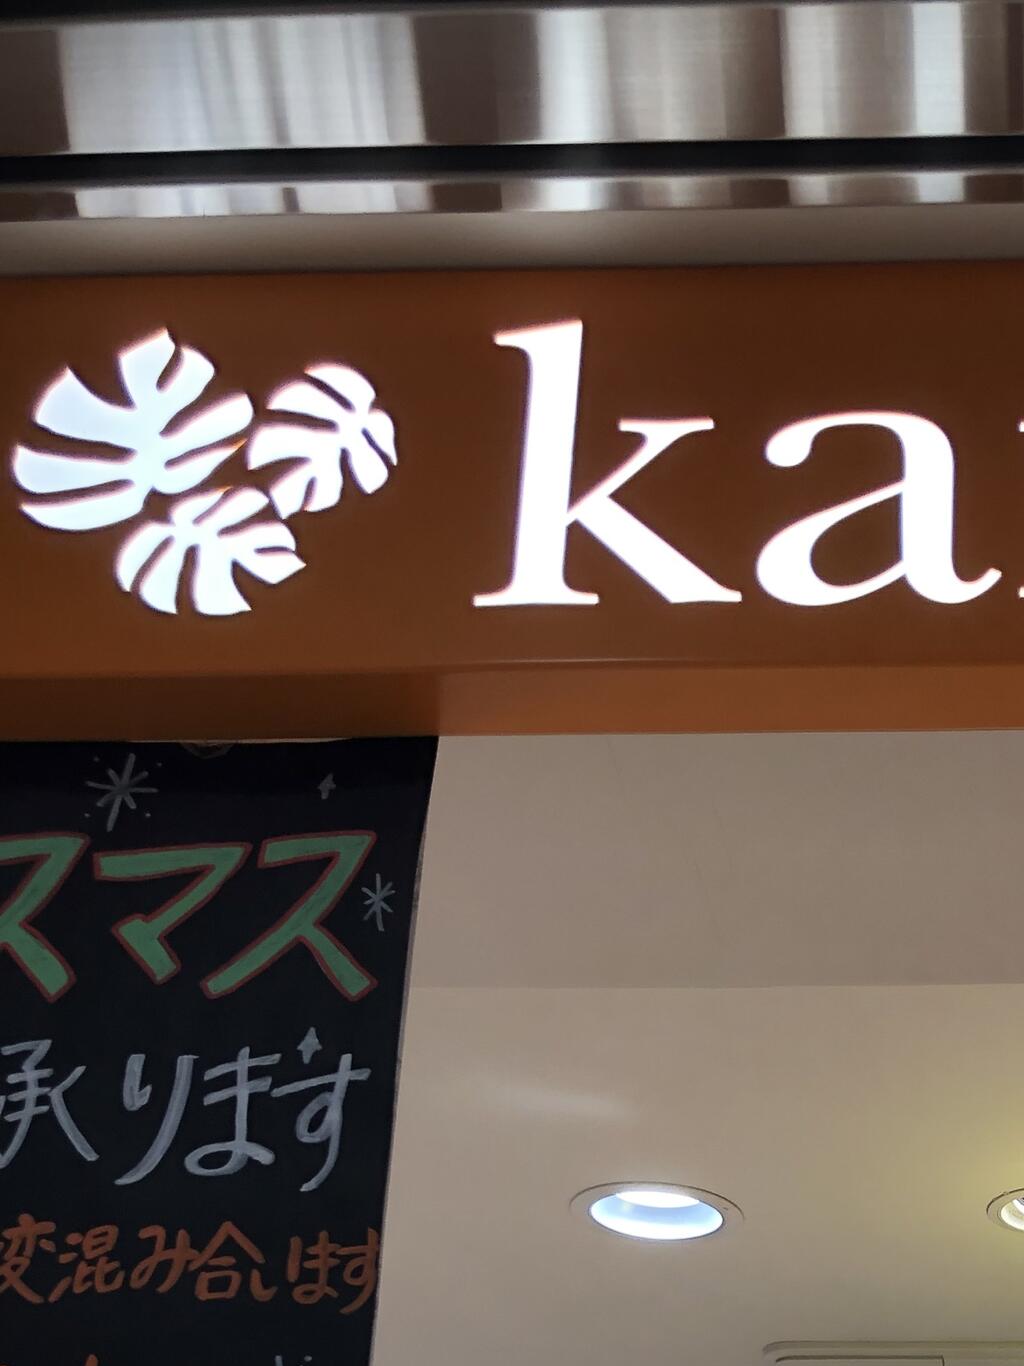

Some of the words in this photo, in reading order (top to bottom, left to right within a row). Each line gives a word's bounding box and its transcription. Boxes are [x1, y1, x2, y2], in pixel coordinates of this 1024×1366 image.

[0, 831, 378, 1001] スマス
[0, 1039, 372, 1192] 承ります
